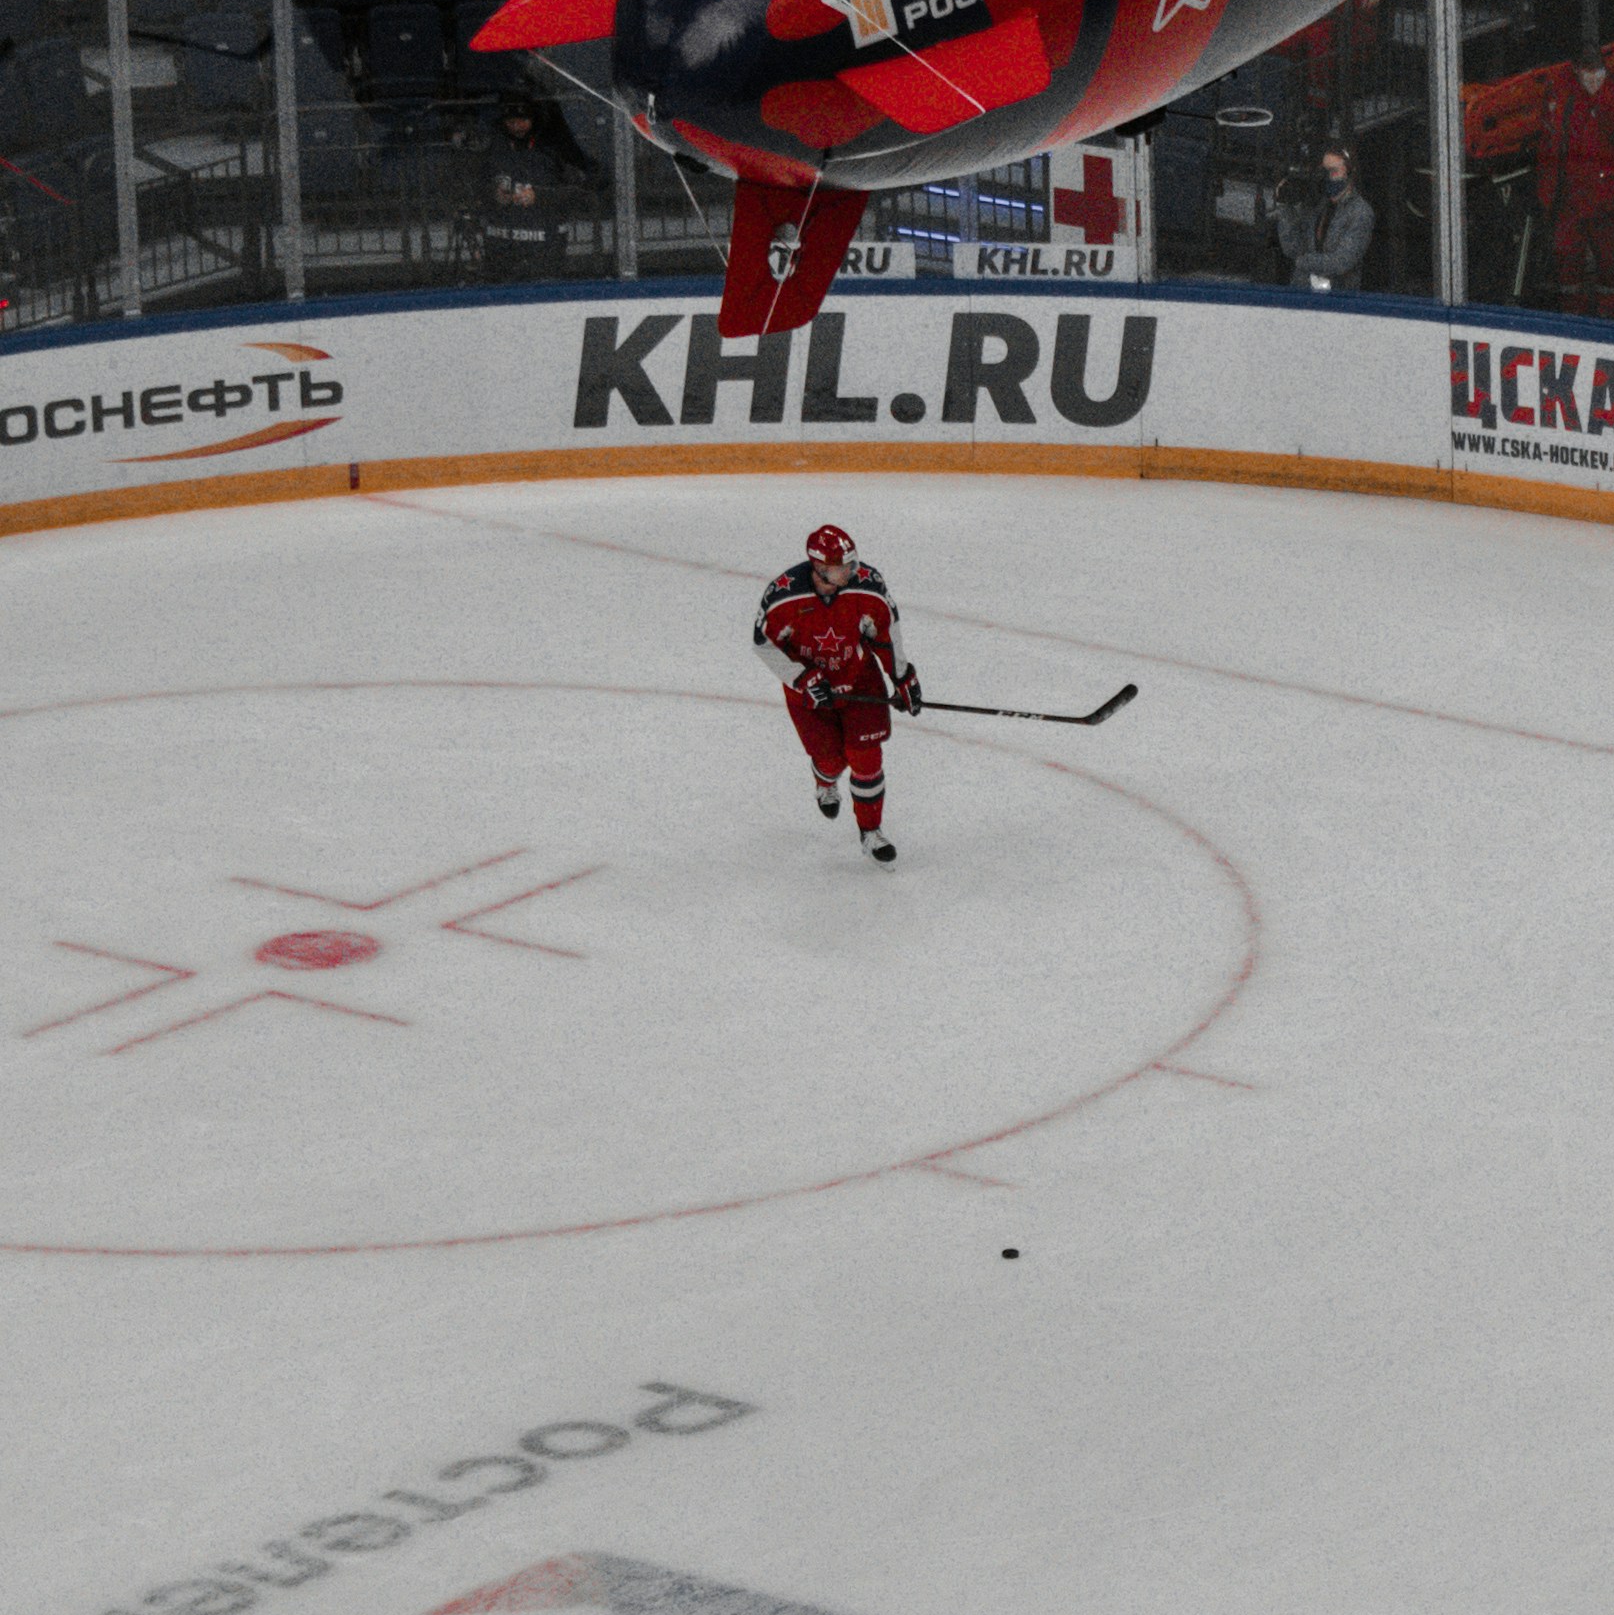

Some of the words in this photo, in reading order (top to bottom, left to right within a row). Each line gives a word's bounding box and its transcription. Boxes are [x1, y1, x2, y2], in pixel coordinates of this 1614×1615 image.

[976, 246, 1114, 277] KHL.RU
[573, 311, 1158, 428] KHL.RU
[0, 370, 344, 446] ОСНЕФТЬ
